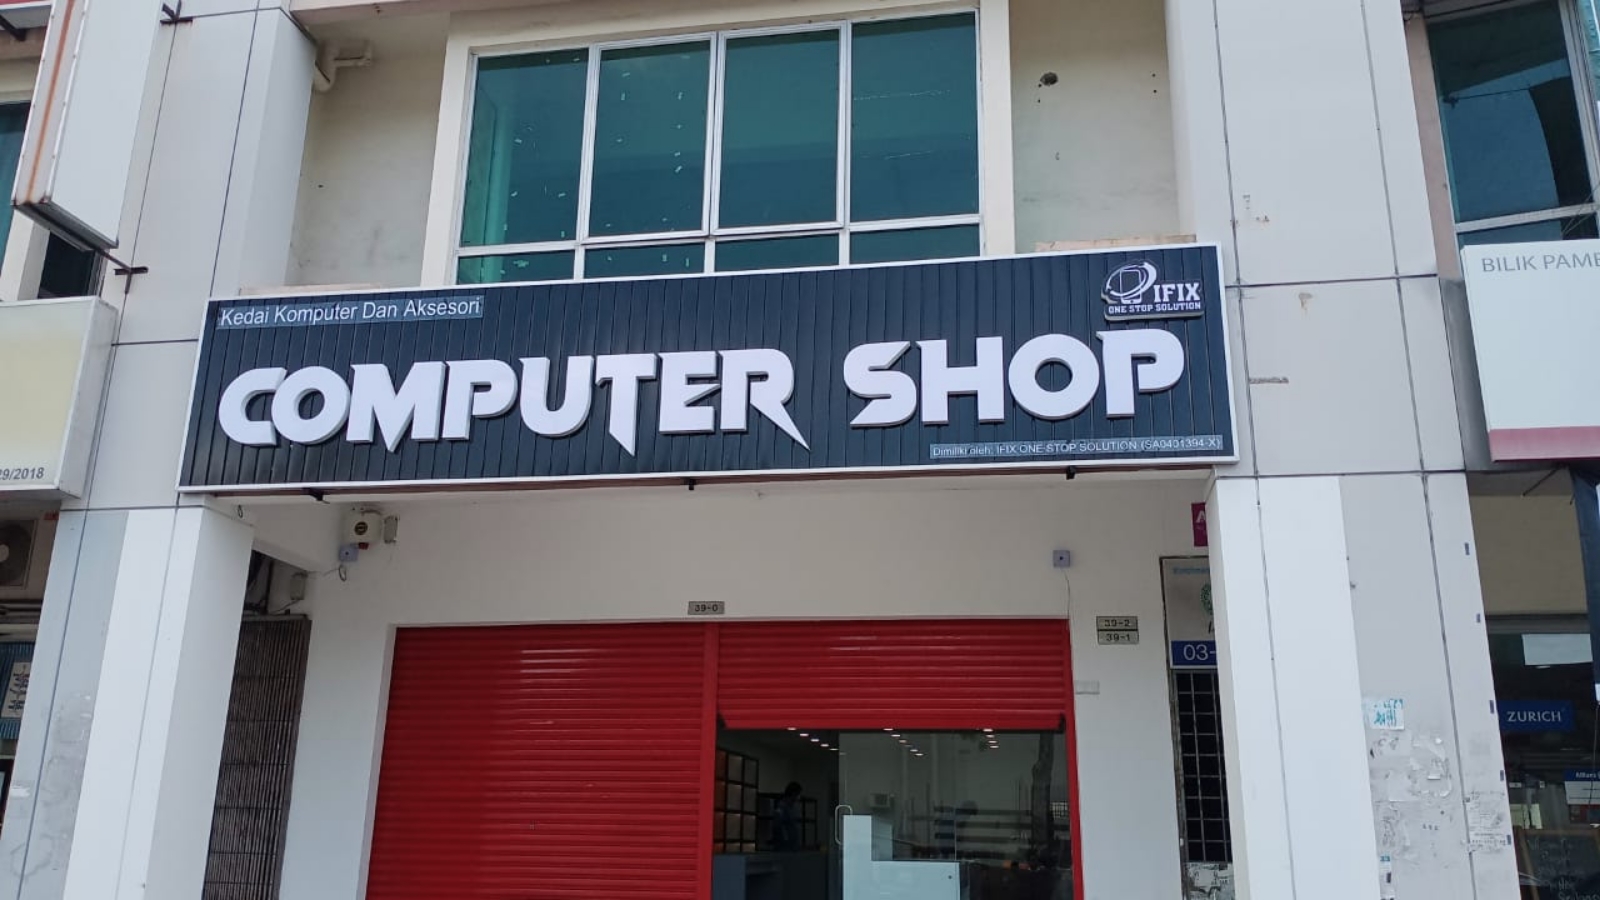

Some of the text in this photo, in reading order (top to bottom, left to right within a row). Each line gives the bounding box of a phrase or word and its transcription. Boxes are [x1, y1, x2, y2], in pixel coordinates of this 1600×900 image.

[1481, 255, 1538, 272] BILIK
[1153, 282, 1201, 303] IFIX
[220, 297, 481, 326] Kedai Komputer Dan Aksesori
[1108, 301, 1201, 314] ONE STOP SOLUTION
[218, 328, 1186, 456] COMPUTER SHOP
[933, 446, 967, 456] Dimiliki
[997, 444, 1017, 455] IFIX
[1080, 440, 1137, 452] SOLUTION
[1141, 437, 1221, 450] (SA0401394-X)
[1506, 711, 1562, 722] ZURICH
